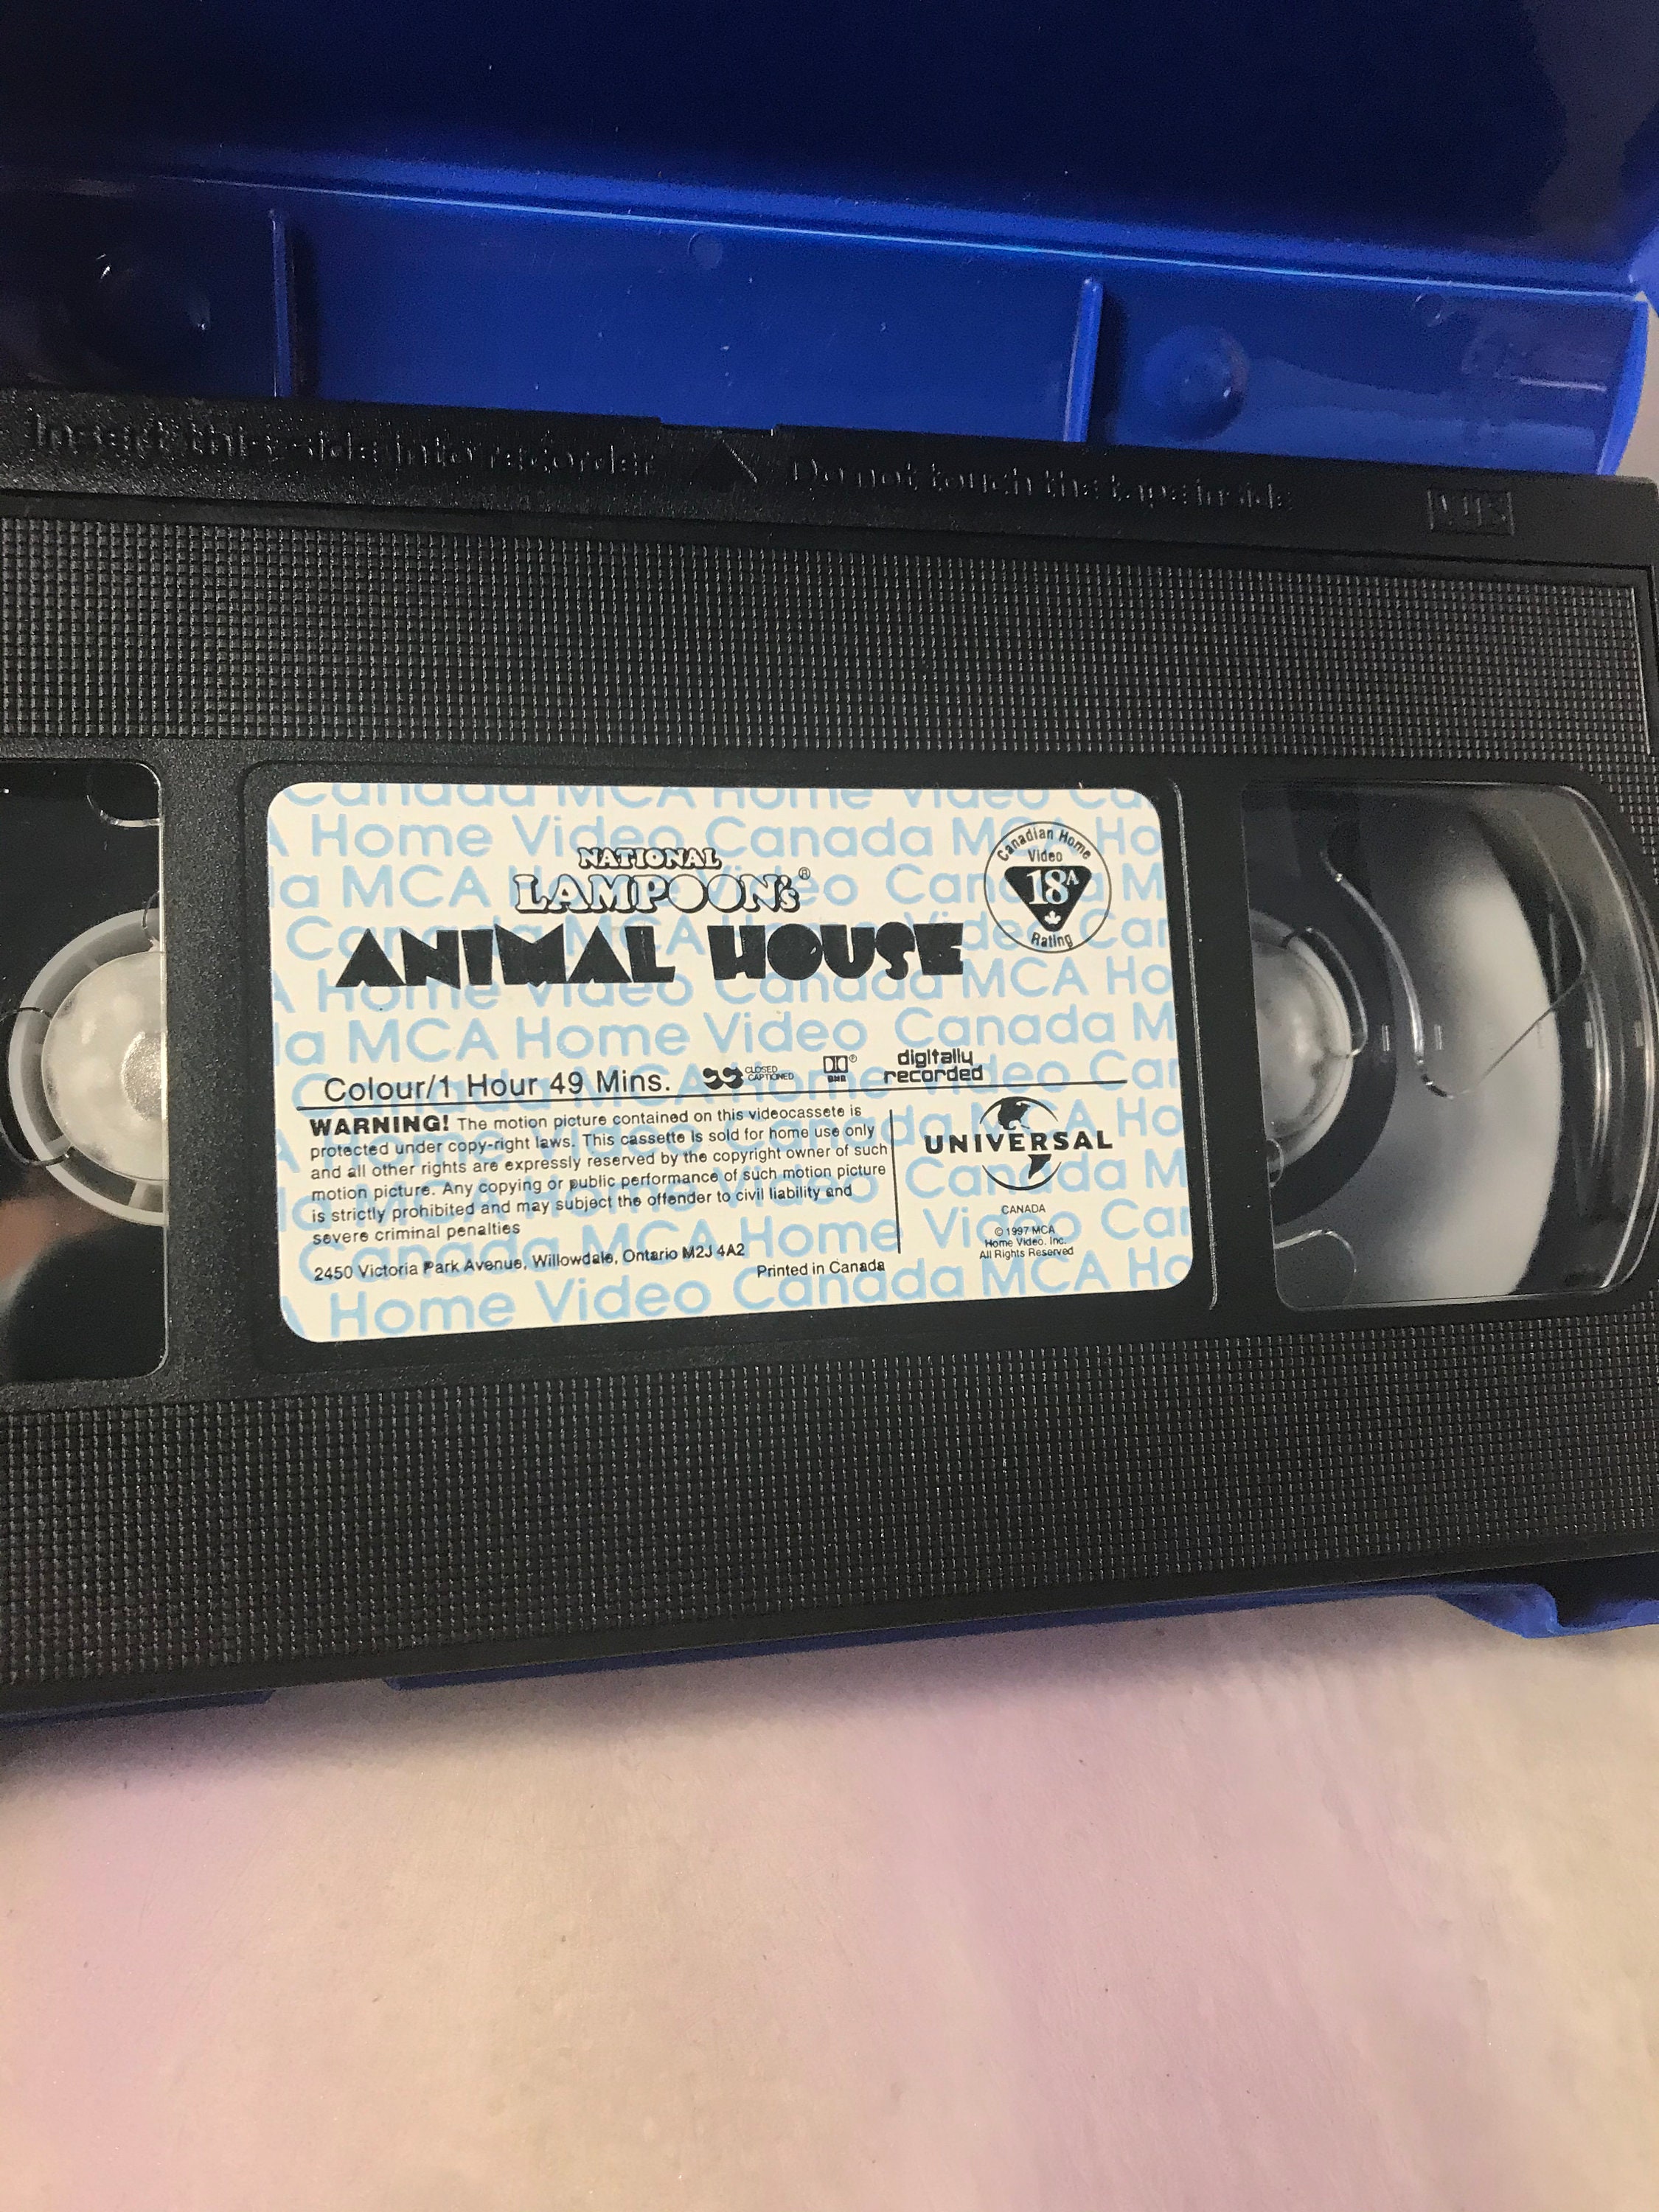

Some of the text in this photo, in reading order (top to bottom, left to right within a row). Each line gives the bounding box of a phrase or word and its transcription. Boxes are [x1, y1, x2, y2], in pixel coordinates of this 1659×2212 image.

[284, 782, 535, 807] Canada
[558, 785, 695, 809] MCA
[714, 787, 873, 810] Home
[313, 814, 493, 858] Home
[512, 815, 684, 858] Video
[706, 815, 933, 858] Canada
[953, 816, 1077, 856] MCA
[1096, 818, 1163, 856] Ho
[996, 827, 1092, 862] Canadian Home
[577, 847, 723, 870] NATIONAL
[1027, 849, 1063, 863] Video
[343, 864, 490, 908] MCA
[335, 922, 676, 990] ANIMAL
[706, 921, 964, 981] HOUSE
[1031, 931, 1074, 948] Rating
[962, 956, 1089, 998] MCA
[1107, 956, 1173, 995] Ho
[349, 1018, 499, 1062] MCA
[517, 1016, 691, 1059] Home
[703, 1011, 868, 1053] Video
[895, 1004, 1115, 1048] Canada
[745, 1065, 778, 1074] CLOSED
[883, 1064, 984, 1084] recorded
[897, 1048, 973, 1068] digitally
[324, 1069, 670, 1102] Colour/1 Hour 49 Mins.
[748, 1072, 795, 1082] CAPTIONED
[309, 1106, 861, 1137] WARNING! The motion picture contained on this videocassete is
[1117, 1097, 1184, 1137] Ho
[310, 1142, 389, 1161] protected
[395, 1141, 442, 1155] under
[448, 1137, 529, 1155] copy-right
[535, 1135, 575, 1149] laws.
[582, 1133, 615, 1147] This
[620, 1131, 685, 1145] cassette
[709, 1128, 739, 1142] sold
[744, 1127, 764, 1140] for
[769, 1127, 809, 1139] home
[814, 1127, 840, 1138] use
[845, 1124, 874, 1138] only
[924, 1130, 1113, 1155] UNIVERSAL
[311, 1143, 888, 1180] and all other rights are expressly reserved by the copyright owner of such
[905, 1152, 1127, 1199] Canada
[312, 1165, 886, 1201] motion picture. Any copying or public performance of such motion picture
[313, 1183, 852, 1223] is strictly prohibited and may subject the offender to civil liability and
[1001, 1204, 1046, 1215] CANADA
[299, 1206, 1082, 1285] Canada MCA Home Video
[313, 1222, 520, 1245] severe criminal penalties
[984, 1239, 1013, 1248] Home
[1048, 1236, 1067, 1245] Inc.
[1006, 1226, 1029, 1236] 1997
[1032, 1225, 1055, 1234] MCA
[314, 1265, 353, 1281] 2450
[358, 1265, 417, 1278] Victoria
[423, 1261, 459, 1274] Park
[622, 1248, 678, 1263] Ontario
[682, 1245, 713, 1259] M2J
[717, 1242, 745, 1257] 4A2
[757, 1259, 886, 1278] Printed in Canada
[979, 1246, 1074, 1261] All Rights Reserved
[330, 1291, 516, 1338] Home
[536, 1275, 713, 1323] Video
[733, 1259, 965, 1310] Canada
[982, 1251, 1110, 1297] MCA
[1128, 1246, 1193, 1288] Ho
